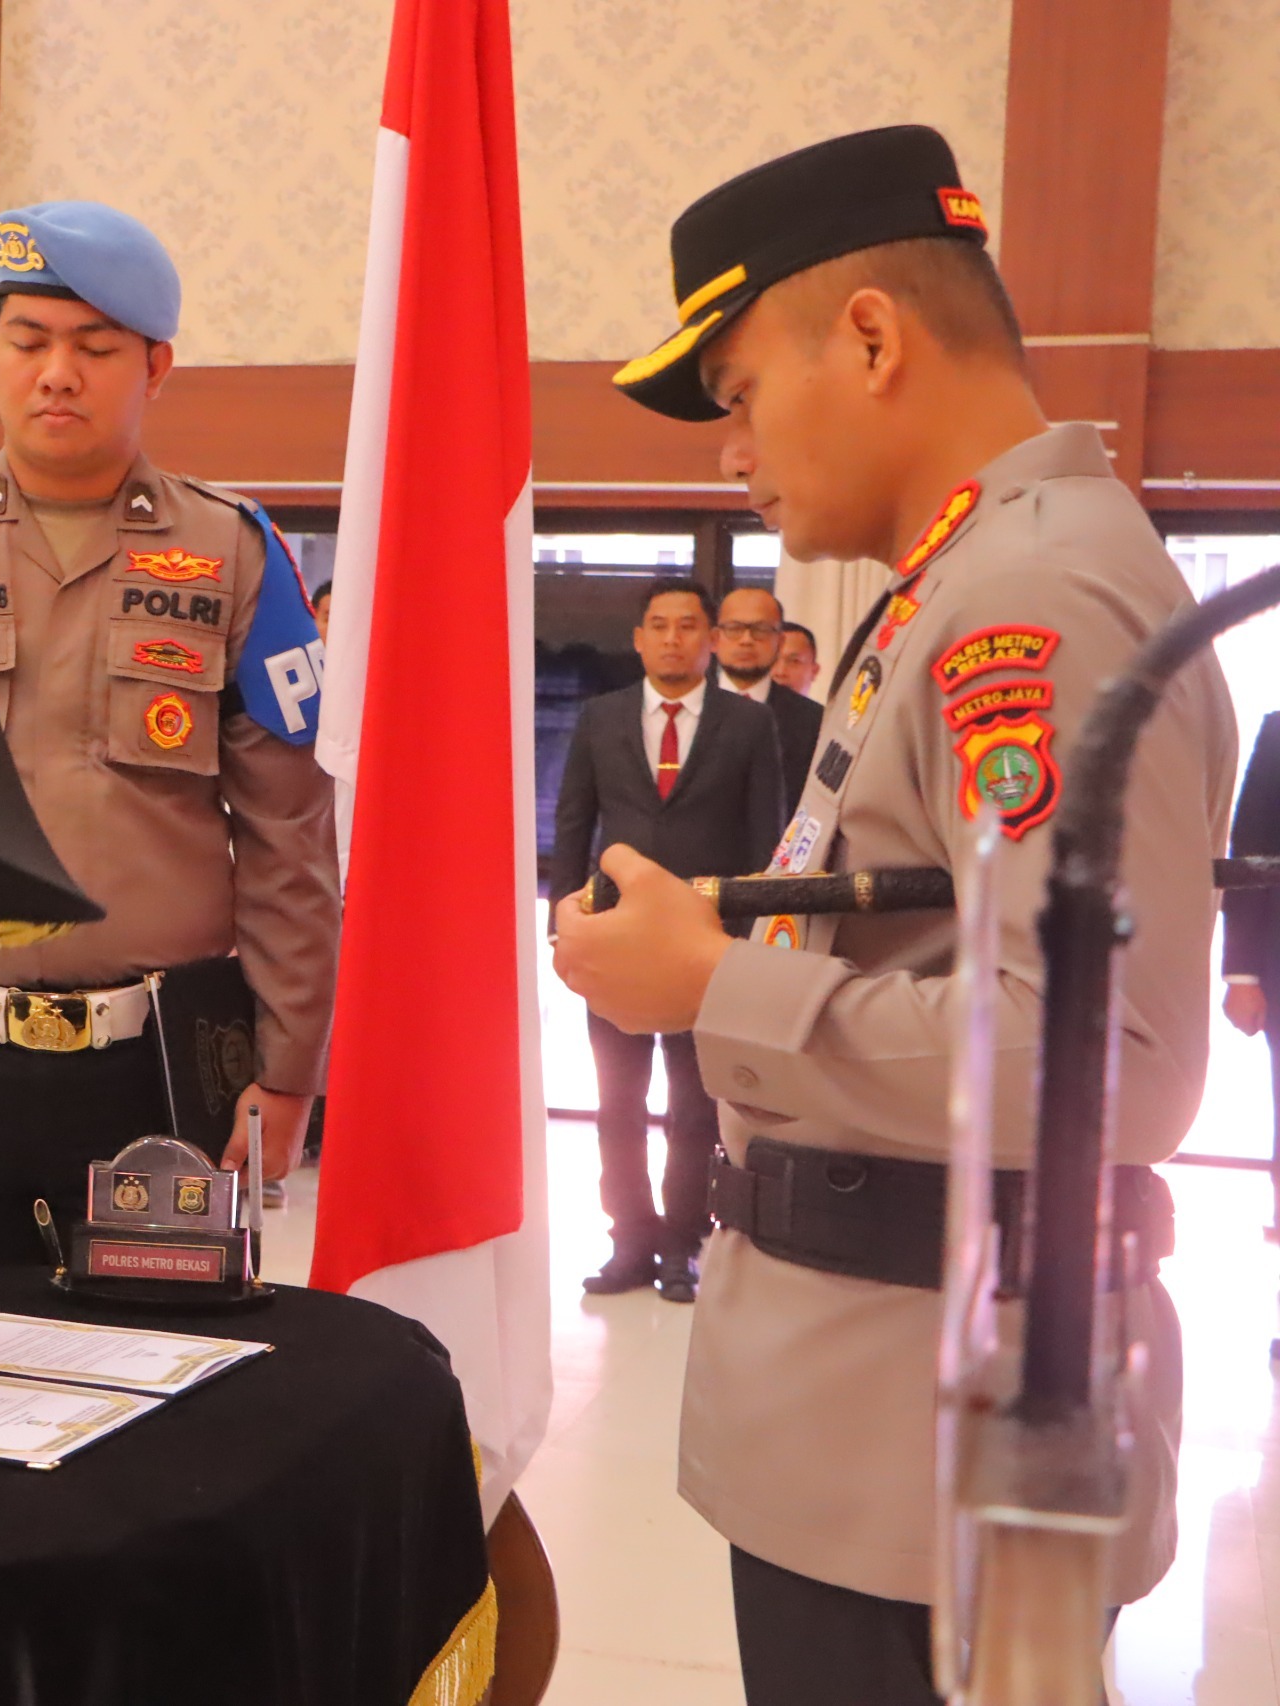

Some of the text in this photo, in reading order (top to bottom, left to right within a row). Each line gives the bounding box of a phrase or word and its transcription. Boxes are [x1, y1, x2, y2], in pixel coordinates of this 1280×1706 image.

[122, 588, 223, 626] POLRI
[943, 633, 1044, 675] POLRES METRO
[957, 647, 1026, 674] BEKASI
[953, 687, 1043, 721] METRO JAYA
[102, 1254, 210, 1273] POLRES METRO BEKASI
